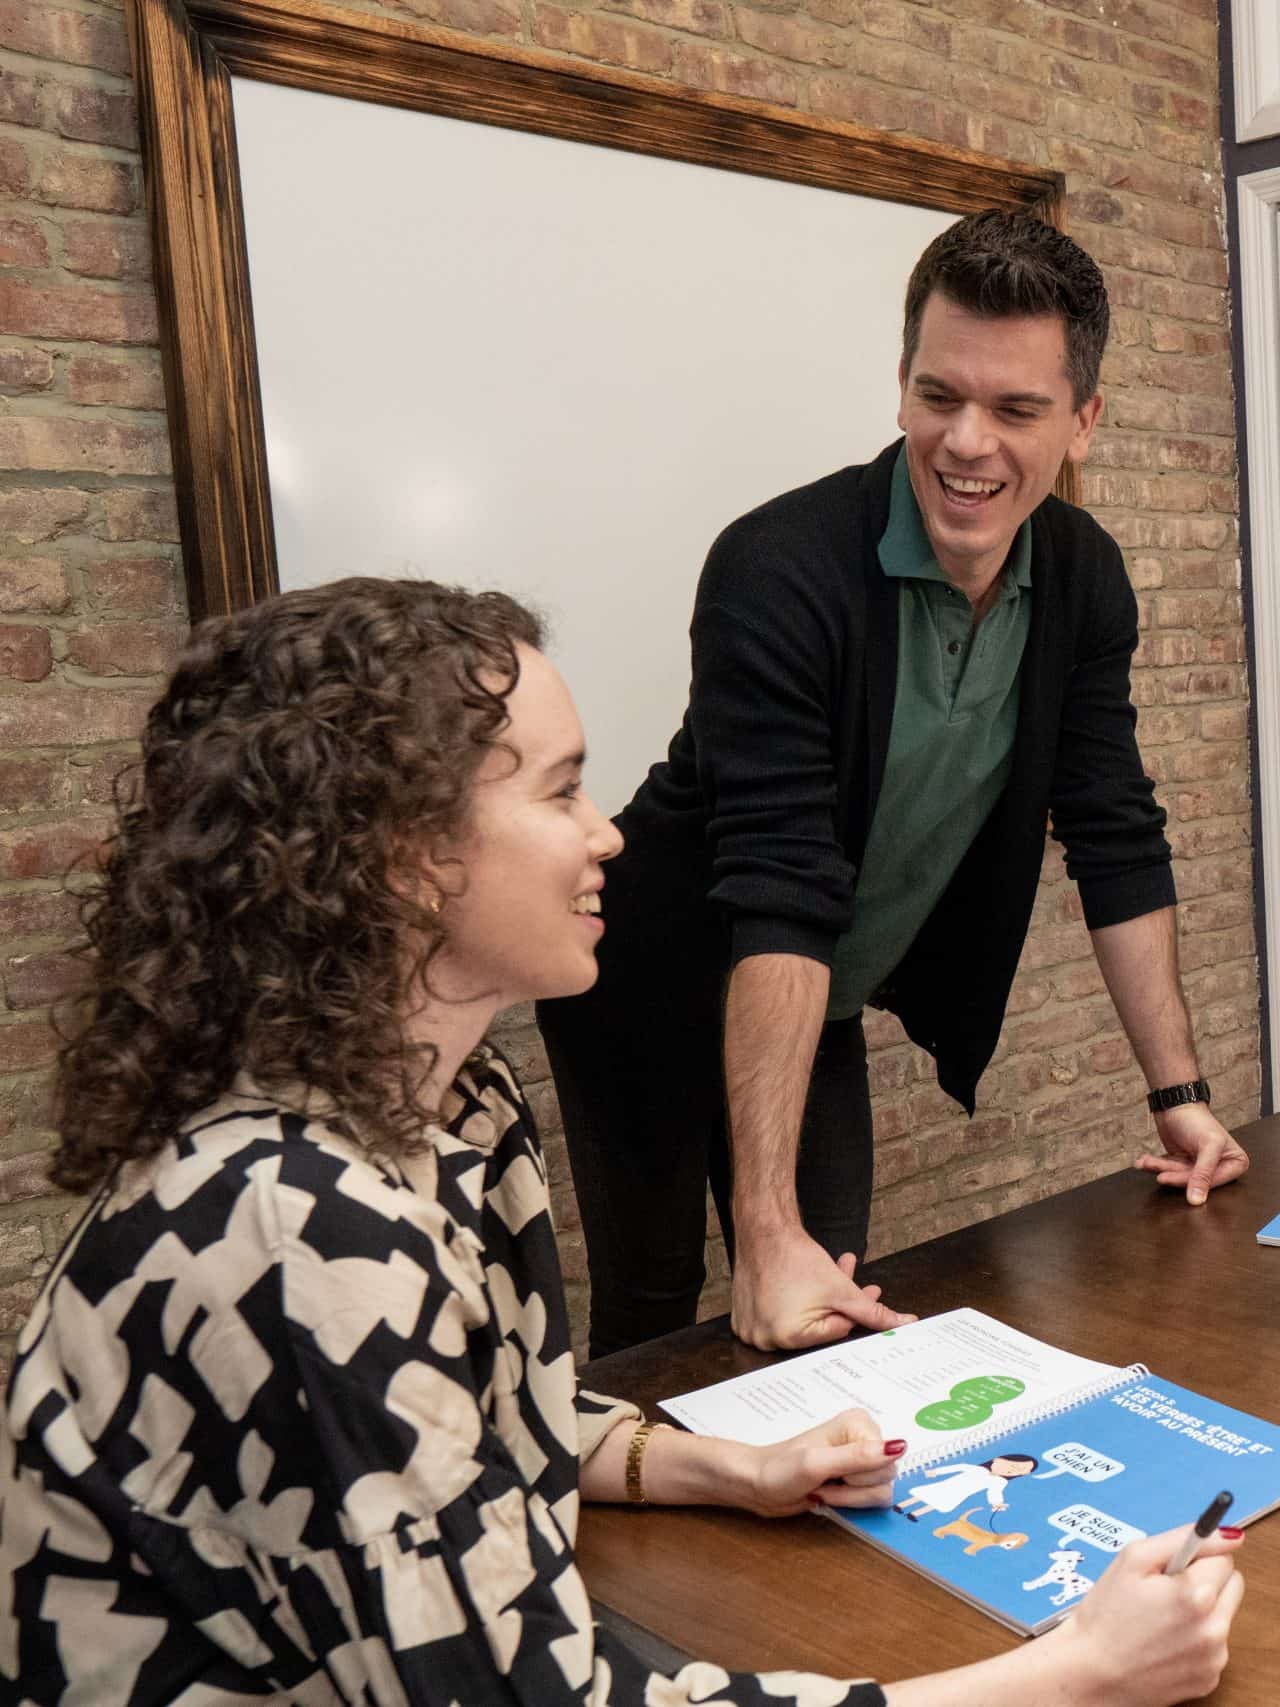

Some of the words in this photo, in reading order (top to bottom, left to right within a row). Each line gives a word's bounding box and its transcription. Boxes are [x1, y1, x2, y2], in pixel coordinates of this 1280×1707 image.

[1121, 1389, 1152, 1405] LES
[1150, 1400, 1206, 1428] VERBES
[1247, 1441, 1274, 1455] ET
[1155, 1417, 1184, 1430] AU
[1053, 1453, 1093, 1473] CHIEN
[1064, 1447, 1092, 1461] J'AI
[1093, 1460, 1115, 1473] UN
[1058, 1514, 1080, 1528] UN
[1079, 1526, 1123, 1549] CHIEN
[1071, 1509, 1091, 1520] JE
[1089, 1517, 1123, 1535] SUIS
